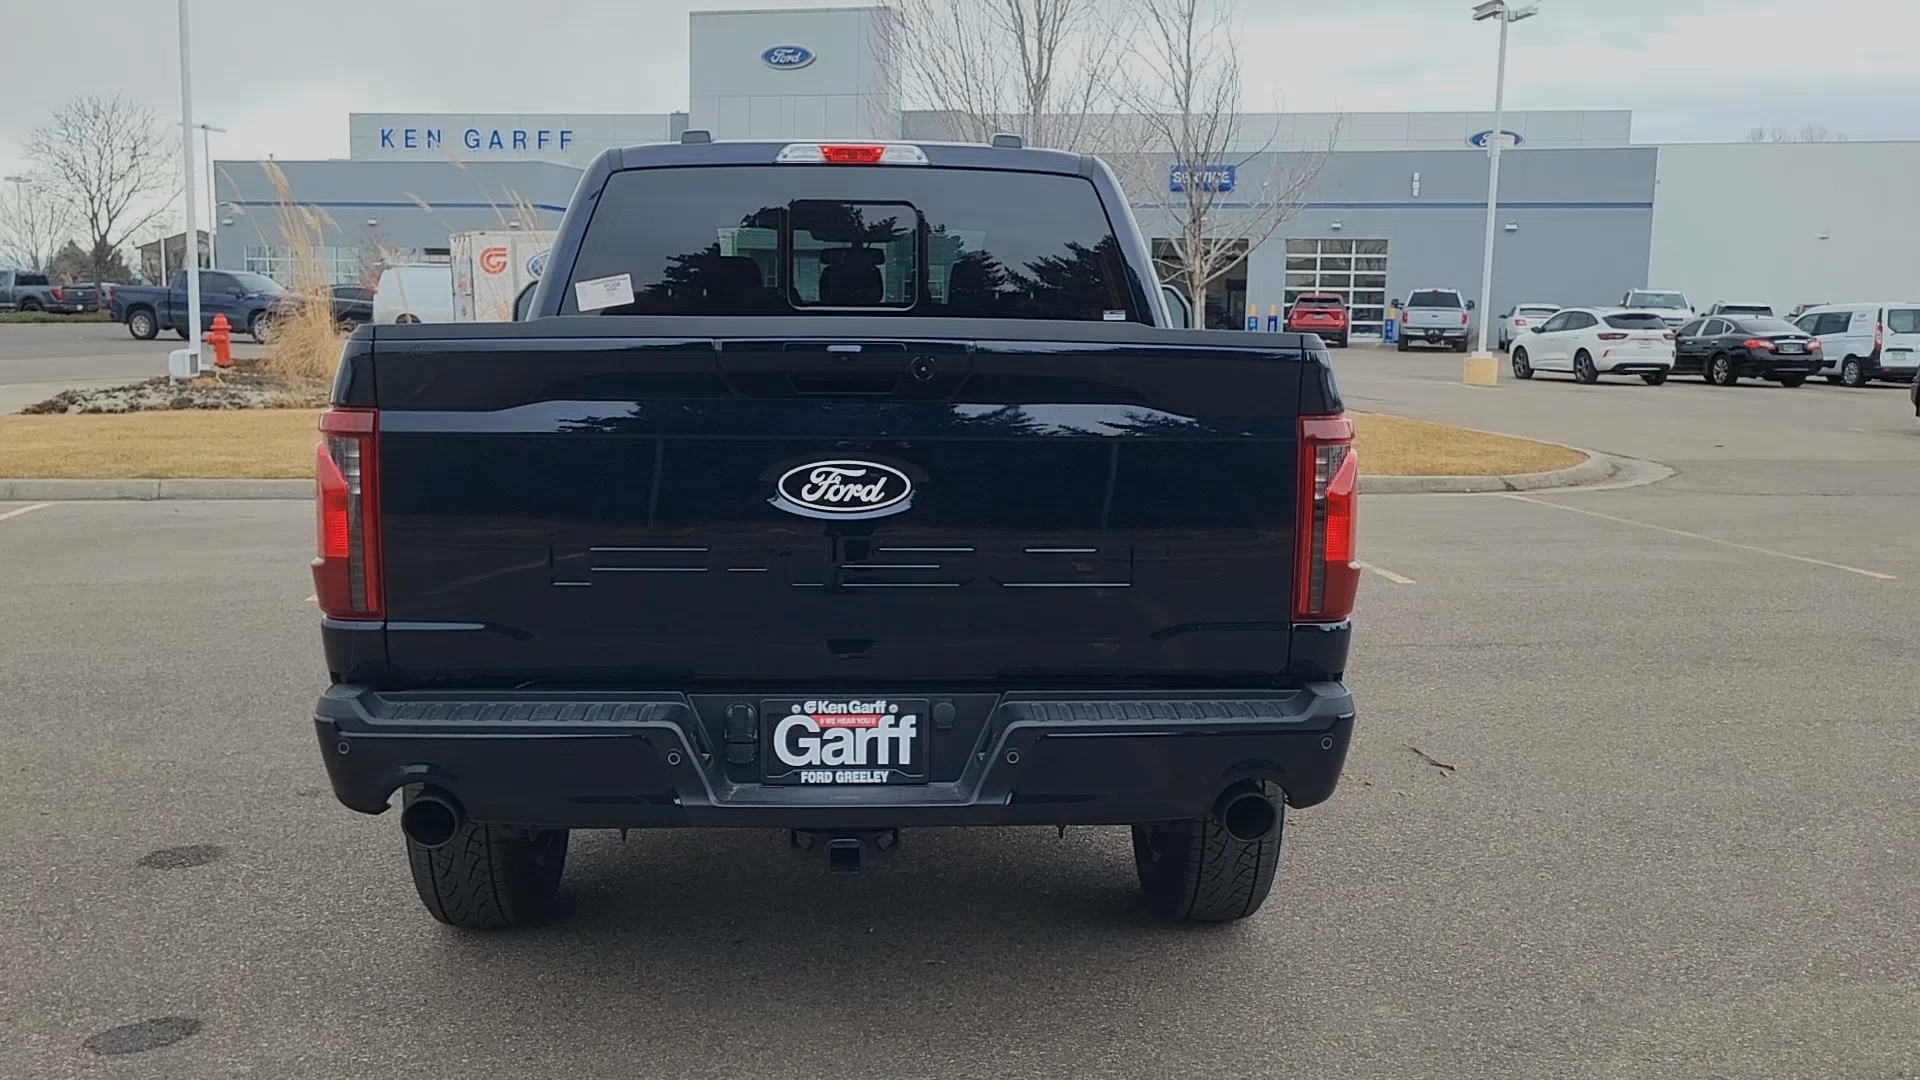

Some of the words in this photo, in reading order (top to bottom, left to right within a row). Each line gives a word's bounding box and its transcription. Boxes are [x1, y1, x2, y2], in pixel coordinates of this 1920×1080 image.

[771, 49, 802, 63] Ford
[380, 128, 442, 149] KEN
[463, 128, 574, 151] GARFF
[801, 466, 888, 503] Ford
[818, 700, 847, 714] Ken
[848, 700, 887, 714] Garff
[825, 717, 836, 725] WE
[837, 717, 856, 725] HEAR
[774, 715, 916, 766] Garff
[801, 771, 833, 784] FORD
[835, 770, 889, 784] GREELEY
